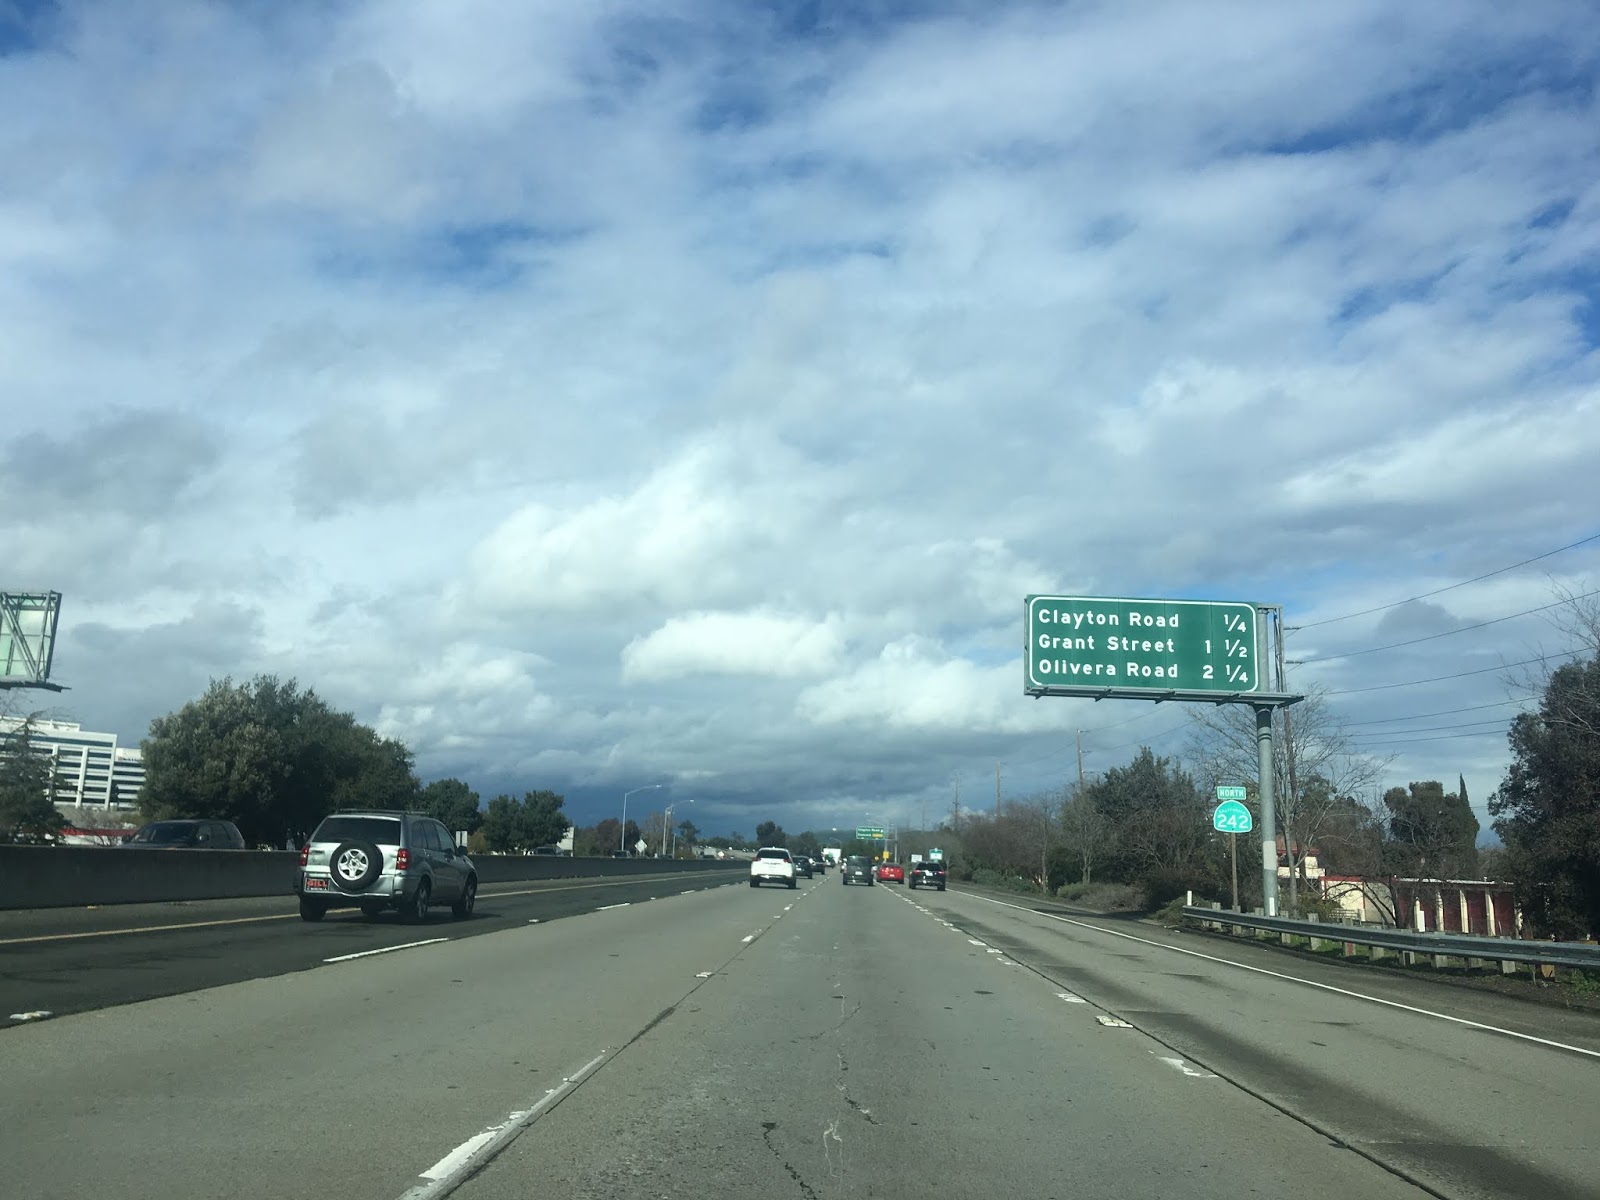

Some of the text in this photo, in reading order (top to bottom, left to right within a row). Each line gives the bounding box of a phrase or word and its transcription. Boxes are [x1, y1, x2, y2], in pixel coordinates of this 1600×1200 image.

[1038, 609, 1119, 630] Clayton
[1129, 612, 1179, 628] Road
[1038, 634, 1095, 650] Grant
[1107, 636, 1175, 653] Street
[1204, 640, 1211, 654] 1
[1039, 659, 1117, 676] Olivera
[1127, 662, 1178, 678] Road
[1202, 665, 1214, 679] 2
[1219, 789, 1244, 797] NORTH
[1218, 815, 1248, 828] 242
